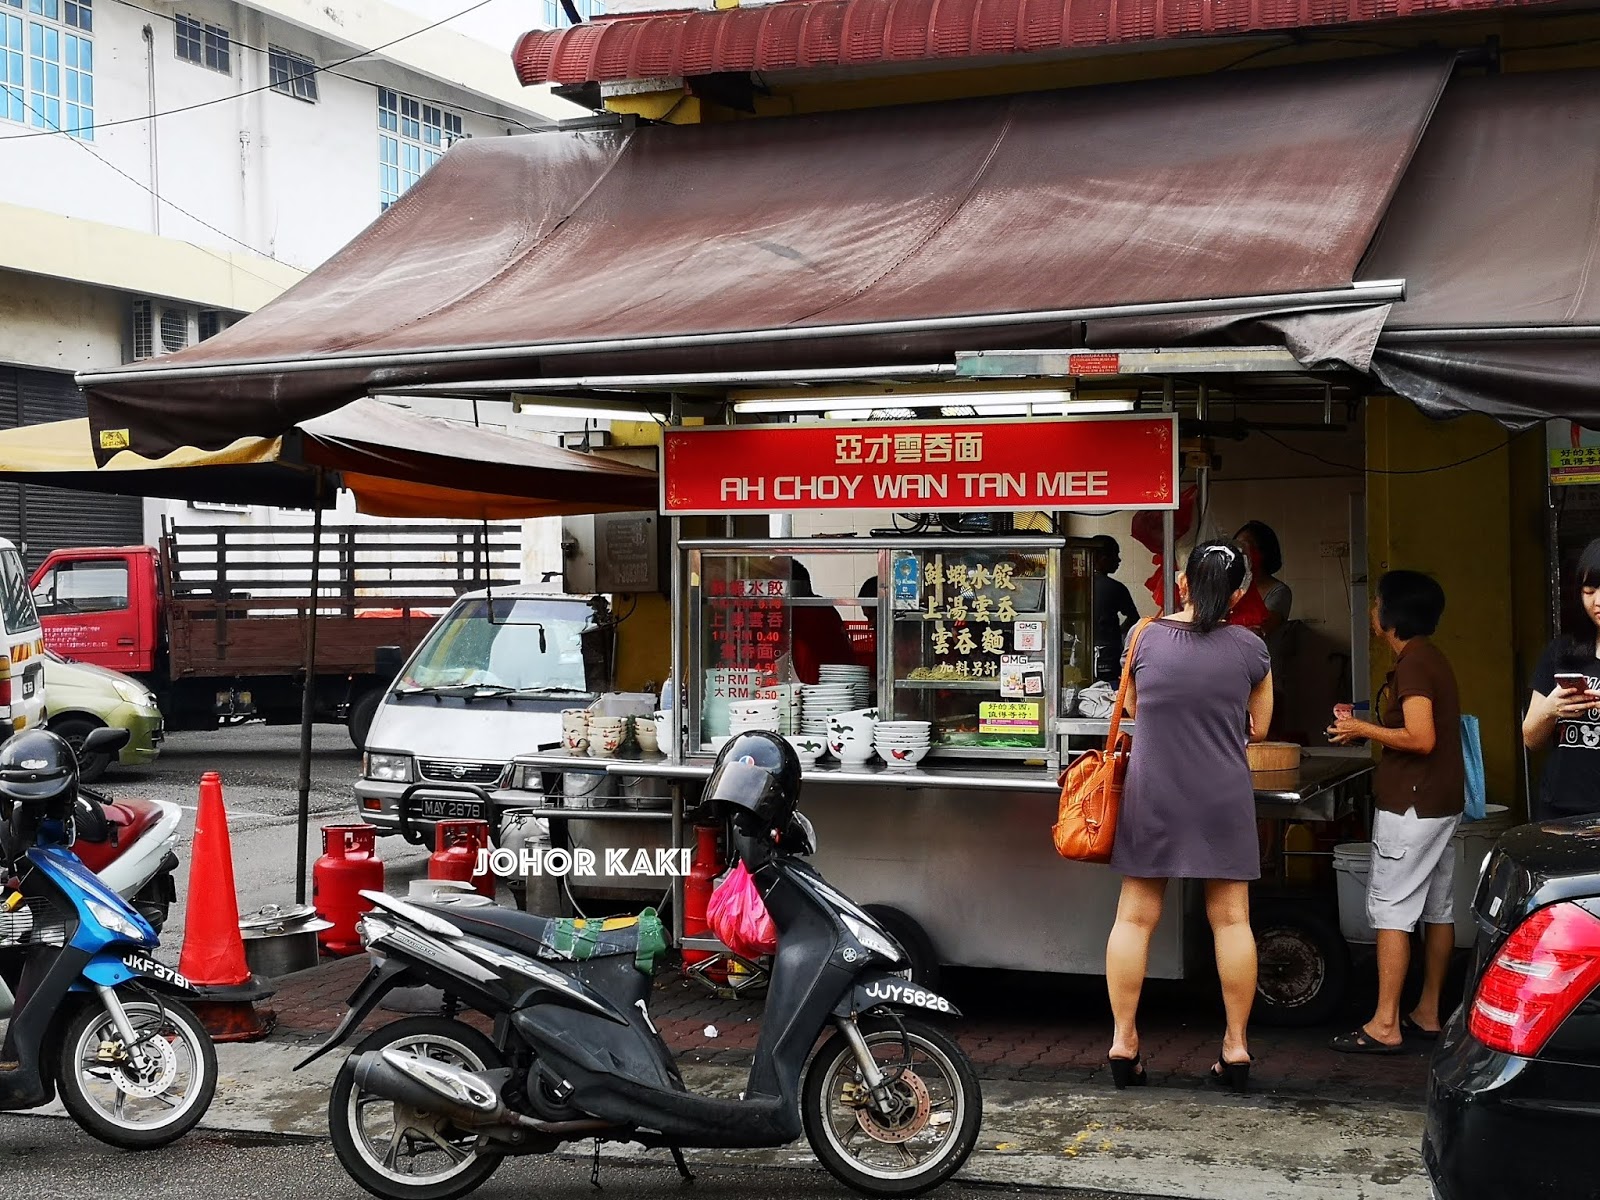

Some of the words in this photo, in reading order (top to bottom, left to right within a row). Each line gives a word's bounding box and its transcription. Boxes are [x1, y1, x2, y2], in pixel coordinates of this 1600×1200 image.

[1560, 448, 1600, 457] 好的东
[720, 476, 765, 501] AH
[773, 475, 864, 501] CHOY
[872, 474, 948, 499] WAN
[957, 472, 1026, 498] TAN
[1036, 471, 1108, 497] MEE
[924, 562, 1016, 590] 鮮蝦水餃
[922, 595, 1021, 624] 上湯雲吞
[756, 631, 779, 641] 0.40
[931, 627, 1005, 655] 雲吞麵
[940, 661, 998, 677] 加料另計
[1001, 655, 1028, 664] OMG
[755, 690, 777, 699] 5.50
[425, 801, 446, 815] MAY
[448, 802, 480, 817] 2878
[122, 954, 190, 989] JKF3781
[865, 982, 949, 1012] JJY5626
